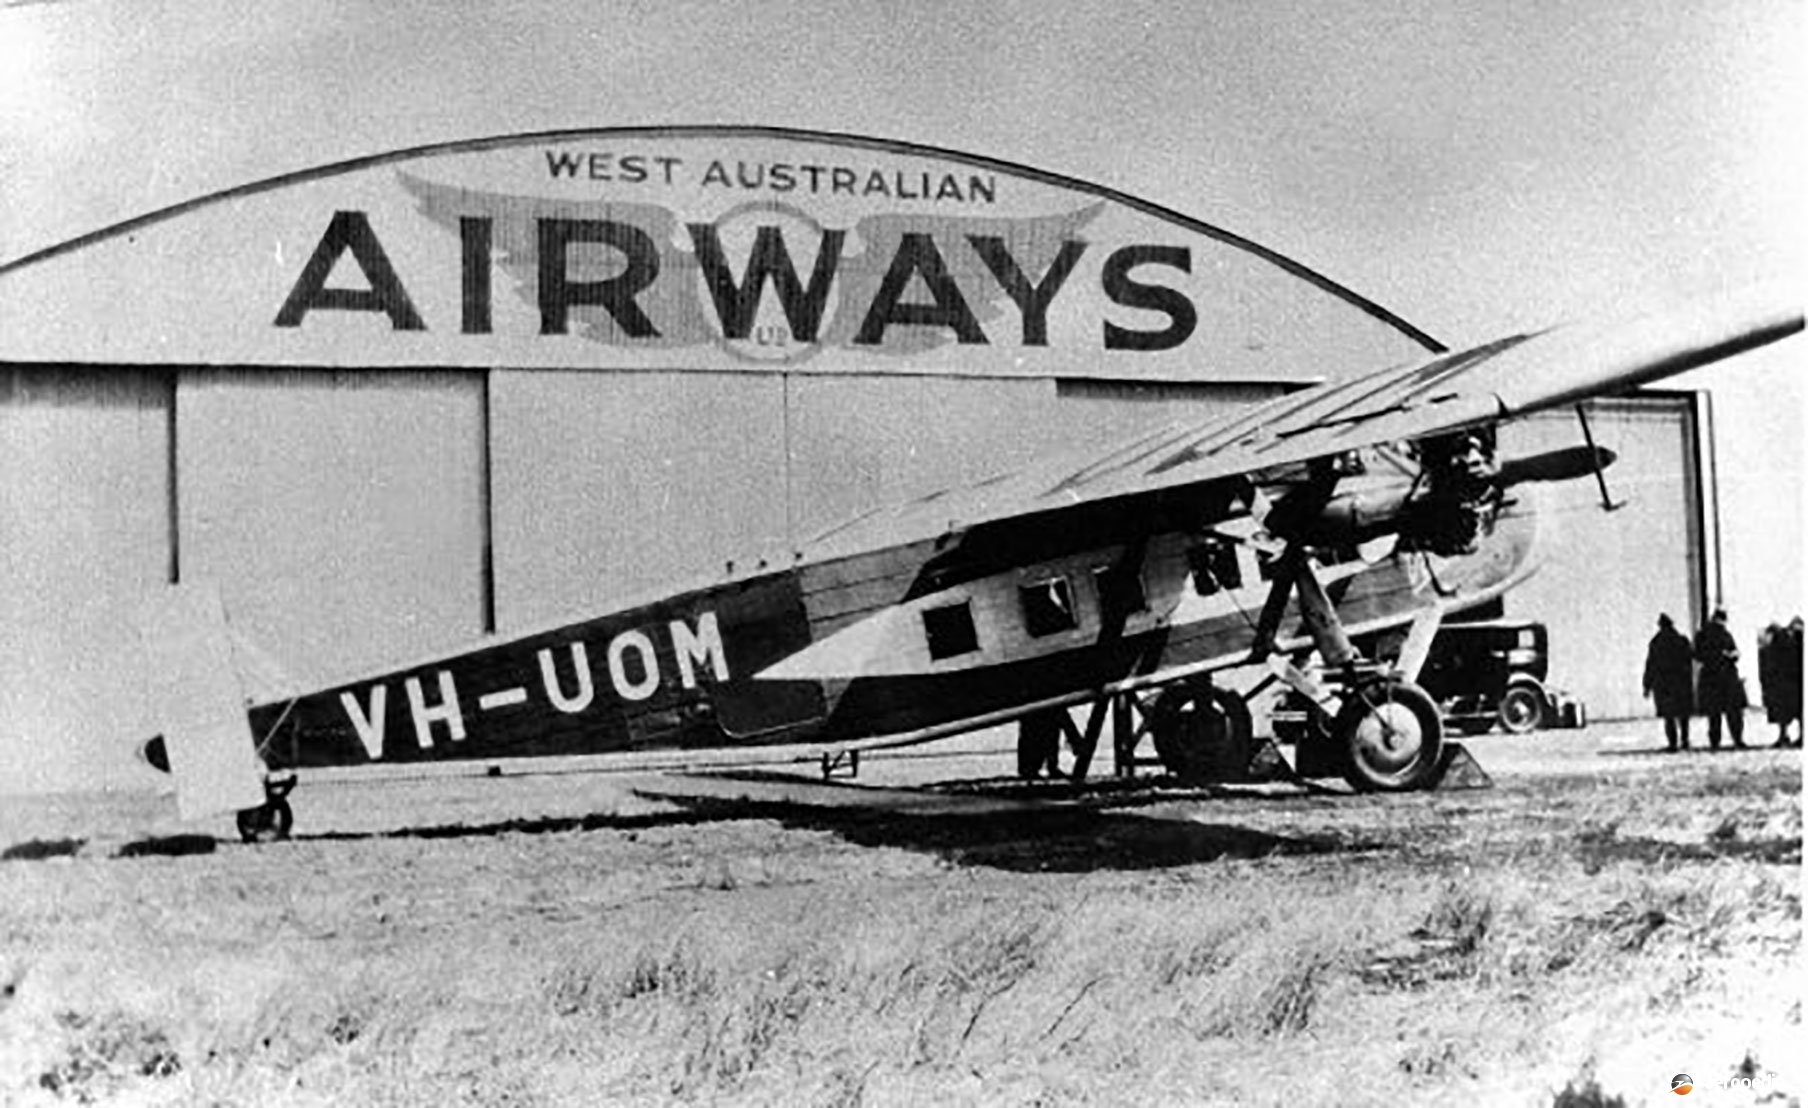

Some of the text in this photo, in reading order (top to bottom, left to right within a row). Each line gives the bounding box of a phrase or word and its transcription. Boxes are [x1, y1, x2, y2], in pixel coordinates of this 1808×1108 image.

[545, 150, 997, 203] WEST AUSTRALIAN
[273, 209, 1198, 351] AIRWAYS
[340, 611, 730, 760] VH-UOM
